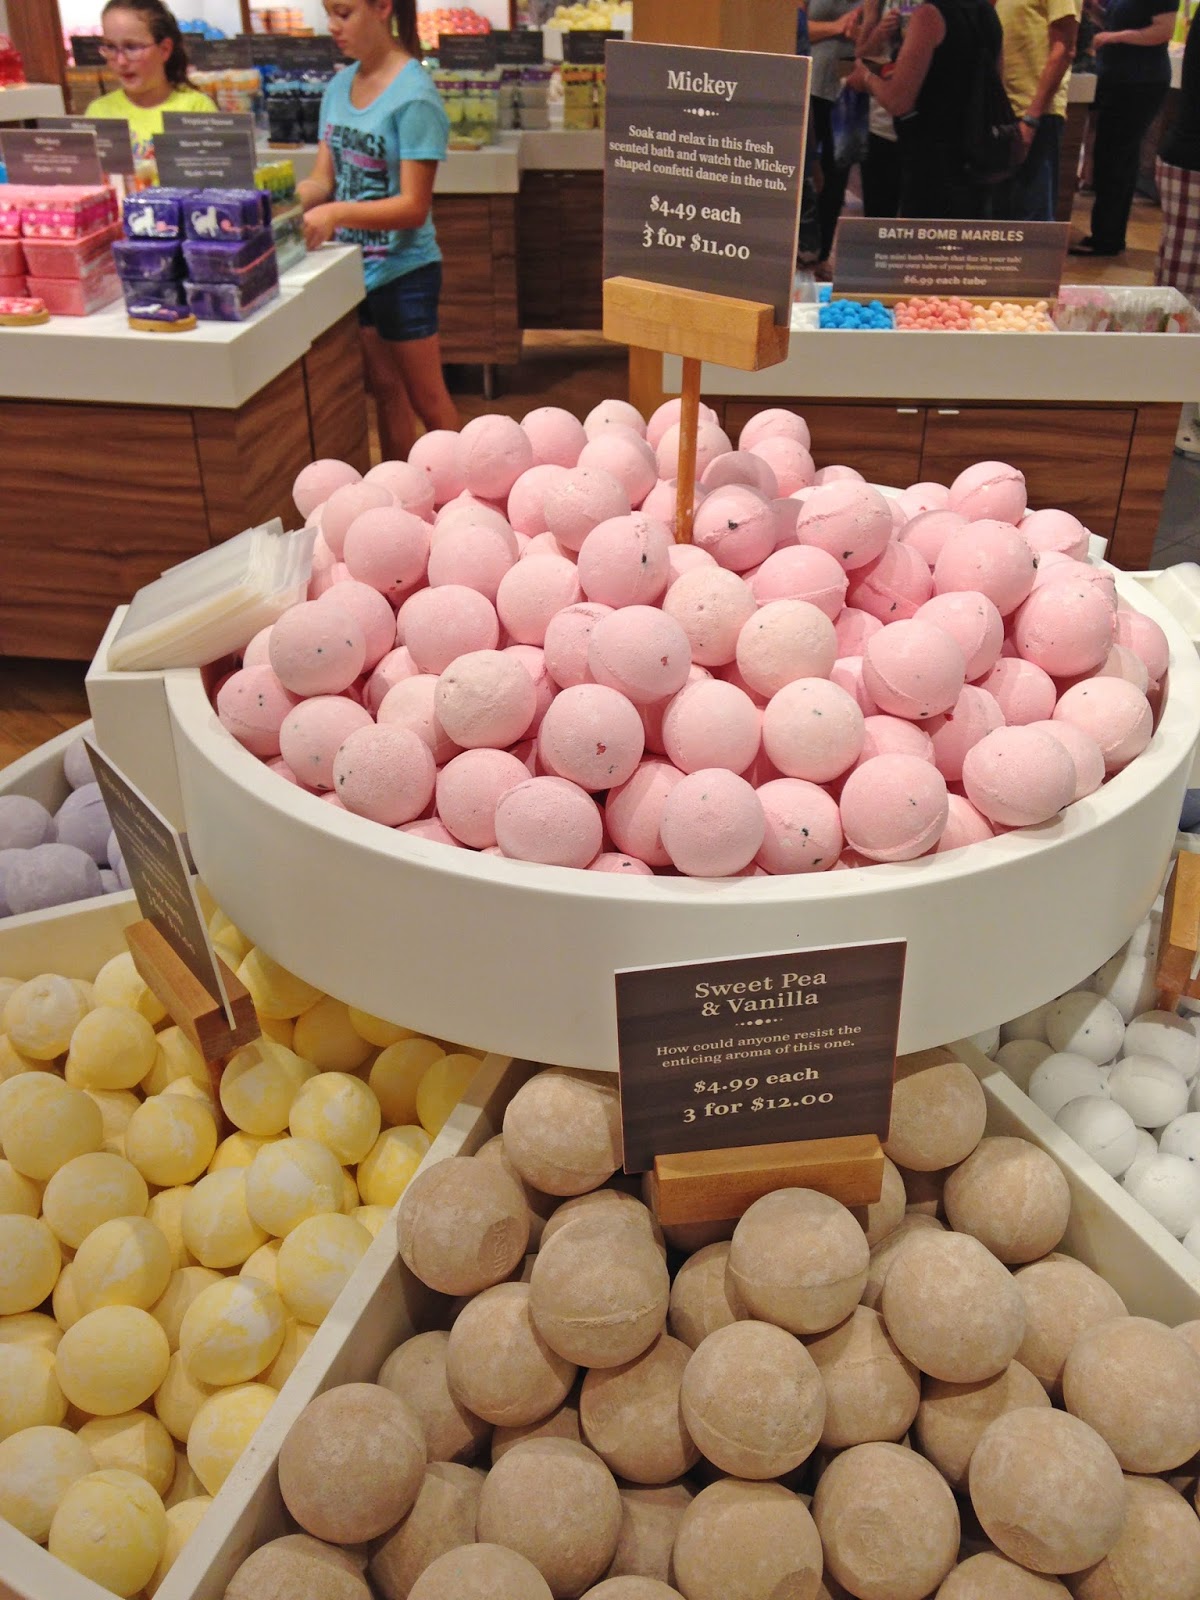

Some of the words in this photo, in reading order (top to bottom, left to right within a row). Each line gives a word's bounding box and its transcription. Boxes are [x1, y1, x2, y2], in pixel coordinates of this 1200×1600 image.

[667, 70, 738, 102] Mickey
[628, 125, 654, 139] Soak
[656, 130, 676, 142] and
[679, 132, 705, 146] relax
[708, 134, 719, 147] in
[721, 136, 742, 150] this
[745, 139, 774, 154] fresh
[609, 141, 648, 155] scented
[651, 144, 675, 158] bath
[677, 148, 697, 162] and
[699, 151, 731, 166] watch
[734, 155, 752, 169] the
[754, 158, 795, 178] Mickey
[614, 156, 651, 173] shaped
[653, 162, 693, 178] confetti
[695, 168, 728, 183] dance
[730, 172, 741, 185] in
[744, 175, 762, 188] the
[764, 178, 787, 192] tub.
[650, 194, 696, 220] $4.49
[701, 206, 741, 224] each
[642, 229, 653, 248] 3
[657, 227, 686, 248] for
[690, 233, 750, 260] $11.00
[878, 228, 913, 240] BATH
[918, 228, 957, 240] BOMB
[961, 229, 1024, 242] MARBLES
[935, 275, 960, 285] each
[962, 275, 988, 286] tube
[694, 977, 773, 999] Sweet
[782, 973, 827, 988] Pea
[701, 1002, 720, 1017] &
[727, 991, 819, 1014] Vanilla
[656, 1043, 689, 1056] How
[693, 1038, 733, 1052] could
[738, 1033, 790, 1047] anyone
[794, 1028, 835, 1041] resist
[837, 1024, 862, 1035] the
[662, 1051, 722, 1068] enticing
[725, 1048, 772, 1061] aroma
[775, 1043, 792, 1055] of
[793, 1040, 820, 1052] this
[824, 1040, 855, 1050] one.
[693, 1077, 759, 1095] $4.99
[766, 1067, 820, 1084] each
[683, 1108, 697, 1123] 3
[704, 1101, 743, 1118] for
[750, 1092, 834, 1112] $12.00
